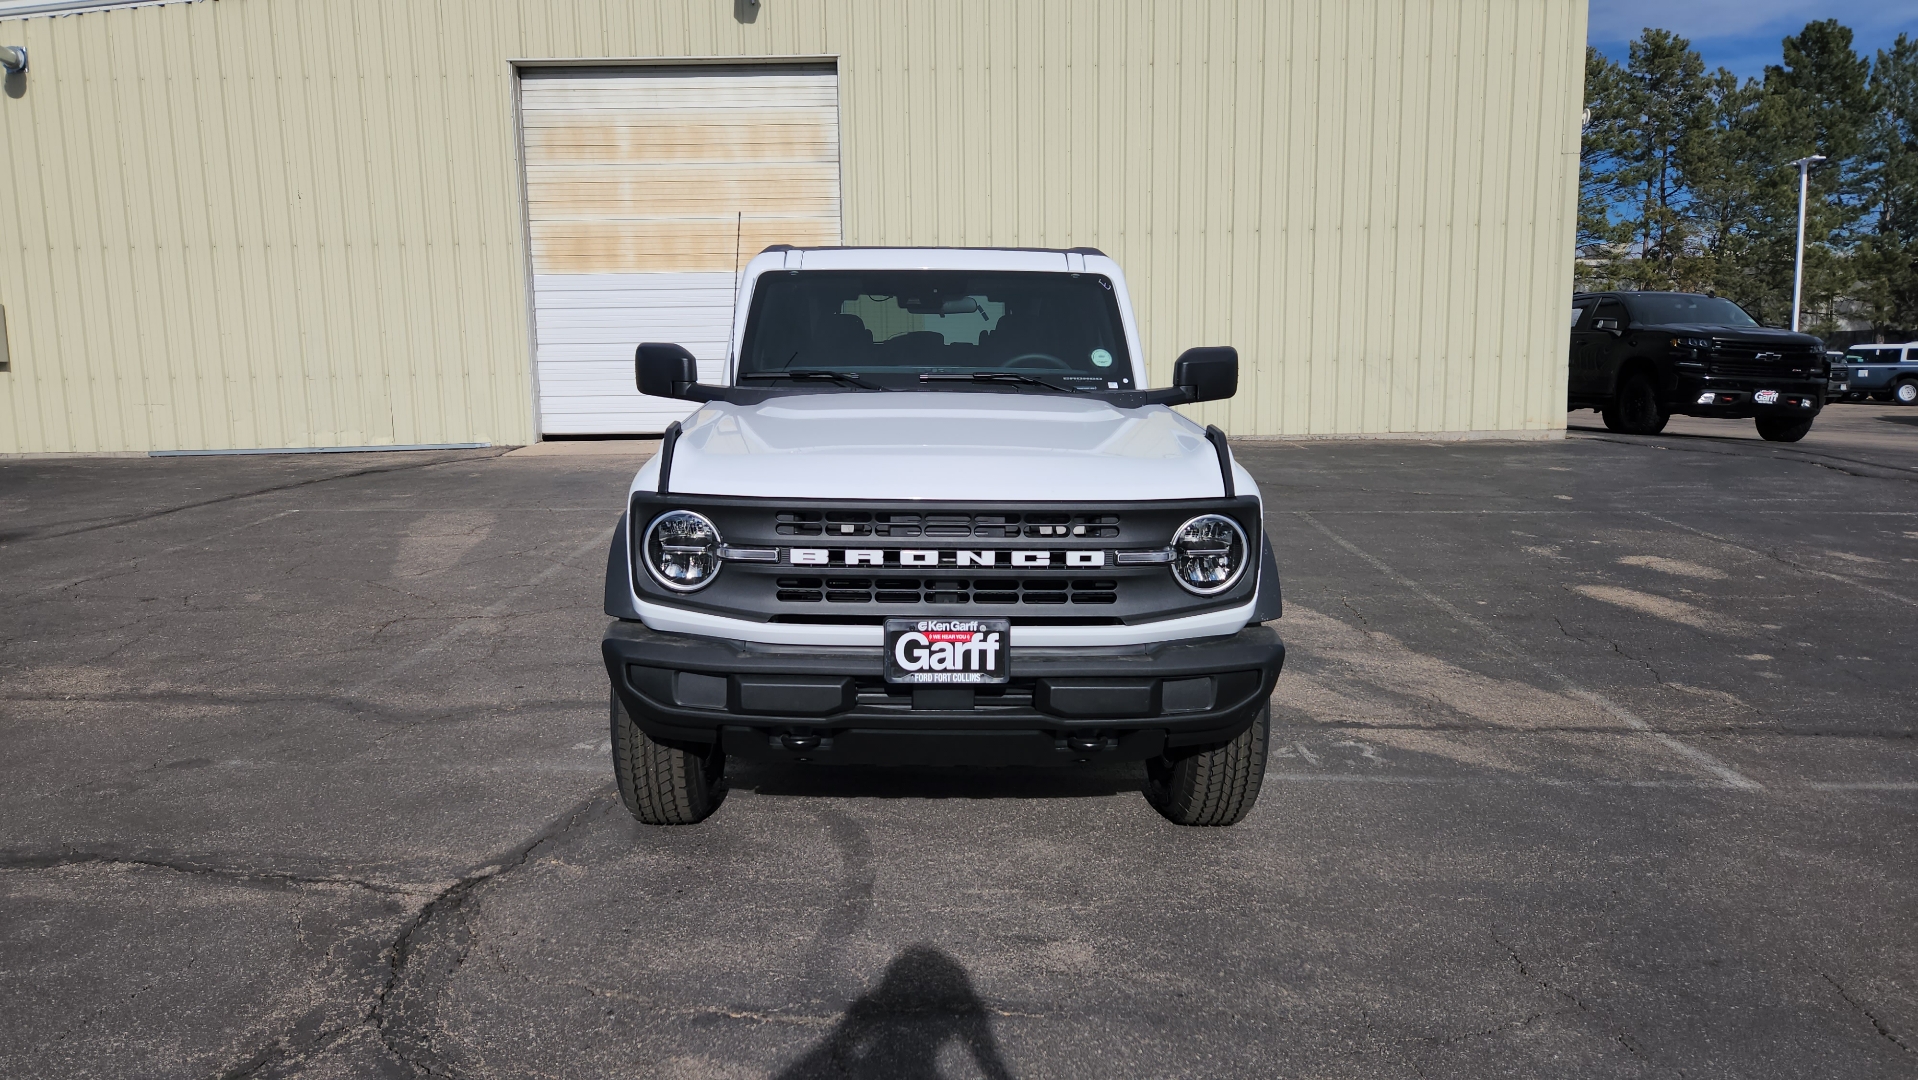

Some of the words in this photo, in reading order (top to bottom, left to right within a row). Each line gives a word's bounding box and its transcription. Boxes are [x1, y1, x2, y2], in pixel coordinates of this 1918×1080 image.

[789, 548, 1105, 566] BRONCO
[927, 620, 949, 632] Ken
[951, 620, 978, 632] Garff
[895, 632, 1000, 671] Garff
[914, 673, 932, 682] FORD
[934, 673, 951, 682] FORT
[953, 673, 981, 682] COLLINS
